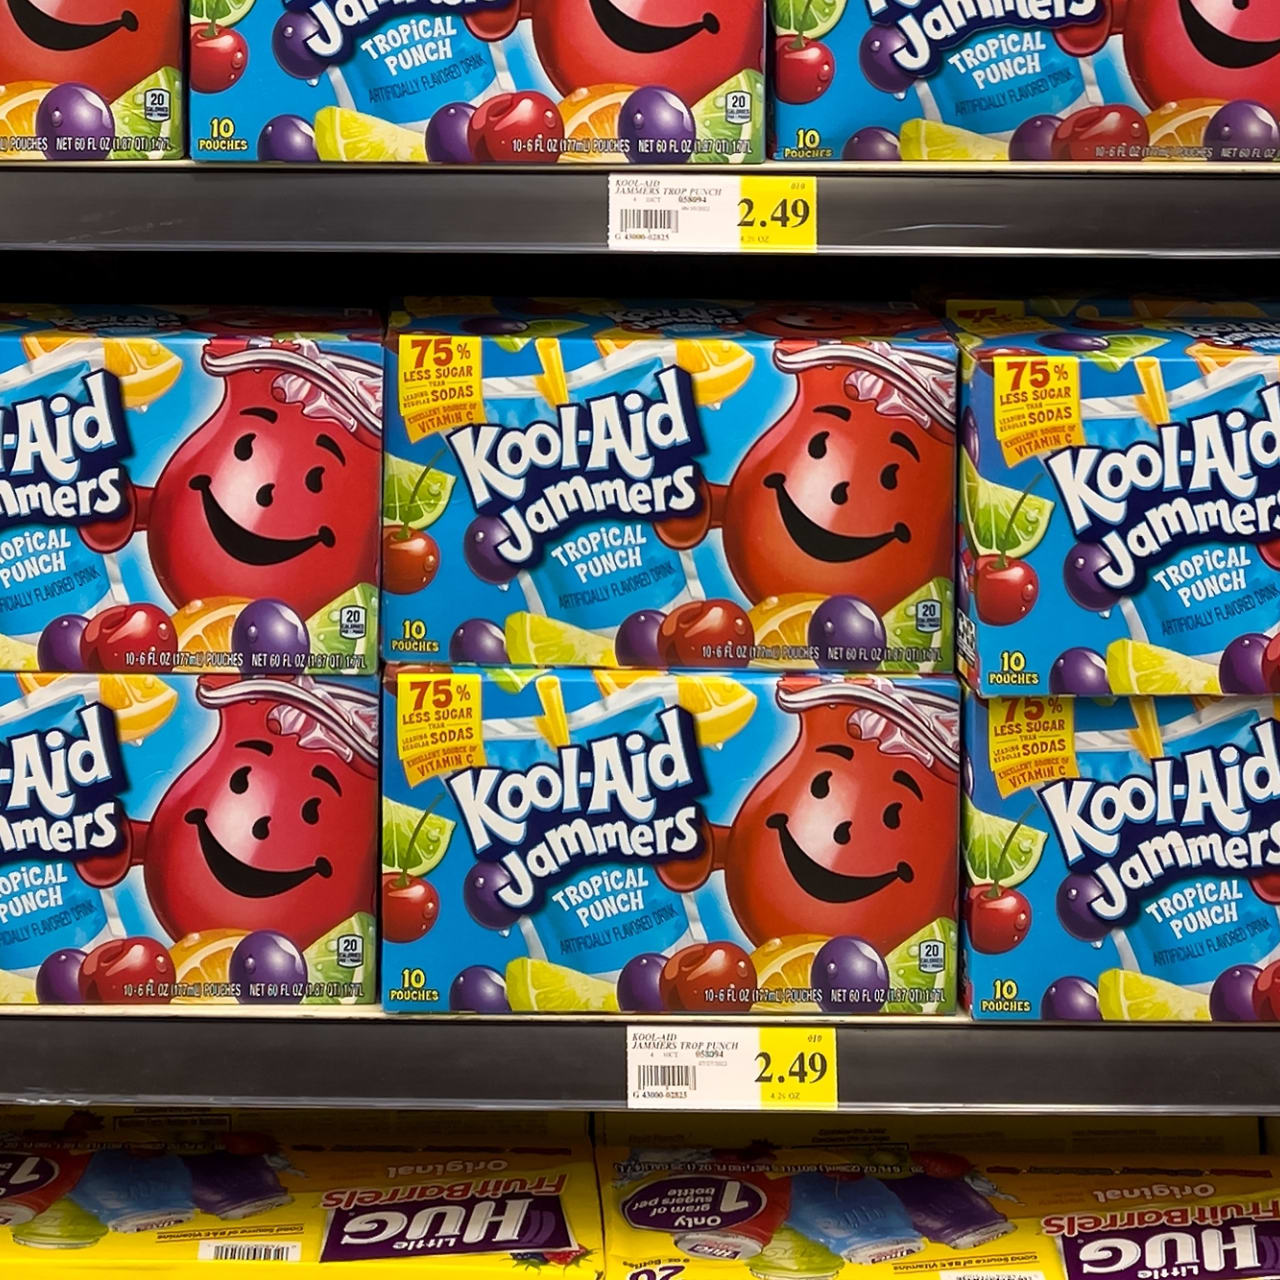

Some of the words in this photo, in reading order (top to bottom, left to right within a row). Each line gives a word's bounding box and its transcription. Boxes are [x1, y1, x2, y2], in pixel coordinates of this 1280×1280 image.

[614, 187, 660, 195] JAMMERS
[663, 188, 687, 196] TROP
[689, 188, 723, 196] PUNCH
[737, 198, 810, 228] 2.49
[450, 369, 690, 505] Kool-Aid
[497, 466, 696, 561] Jammers
[1177, 568, 1246, 607] PUNCH
[921, 607, 935, 619] 20
[576, 889, 644, 926] PUNCH
[632, 1033, 677, 1041] KOOL-AID
[632, 1041, 677, 1050] JAMMERS
[680, 1042, 705, 1050] TROP
[706, 1042, 739, 1050] PUNCH
[754, 1052, 827, 1083] 2.49
[386, 1160, 508, 1178] Original
[667, 1187, 716, 1196] bottle
[1093, 1183, 1215, 1202] Original
[342, 1197, 538, 1246] HUG
[674, 1215, 722, 1228] Only
[392, 1237, 455, 1250] Little
[1078, 1224, 1261, 1274] HUG
